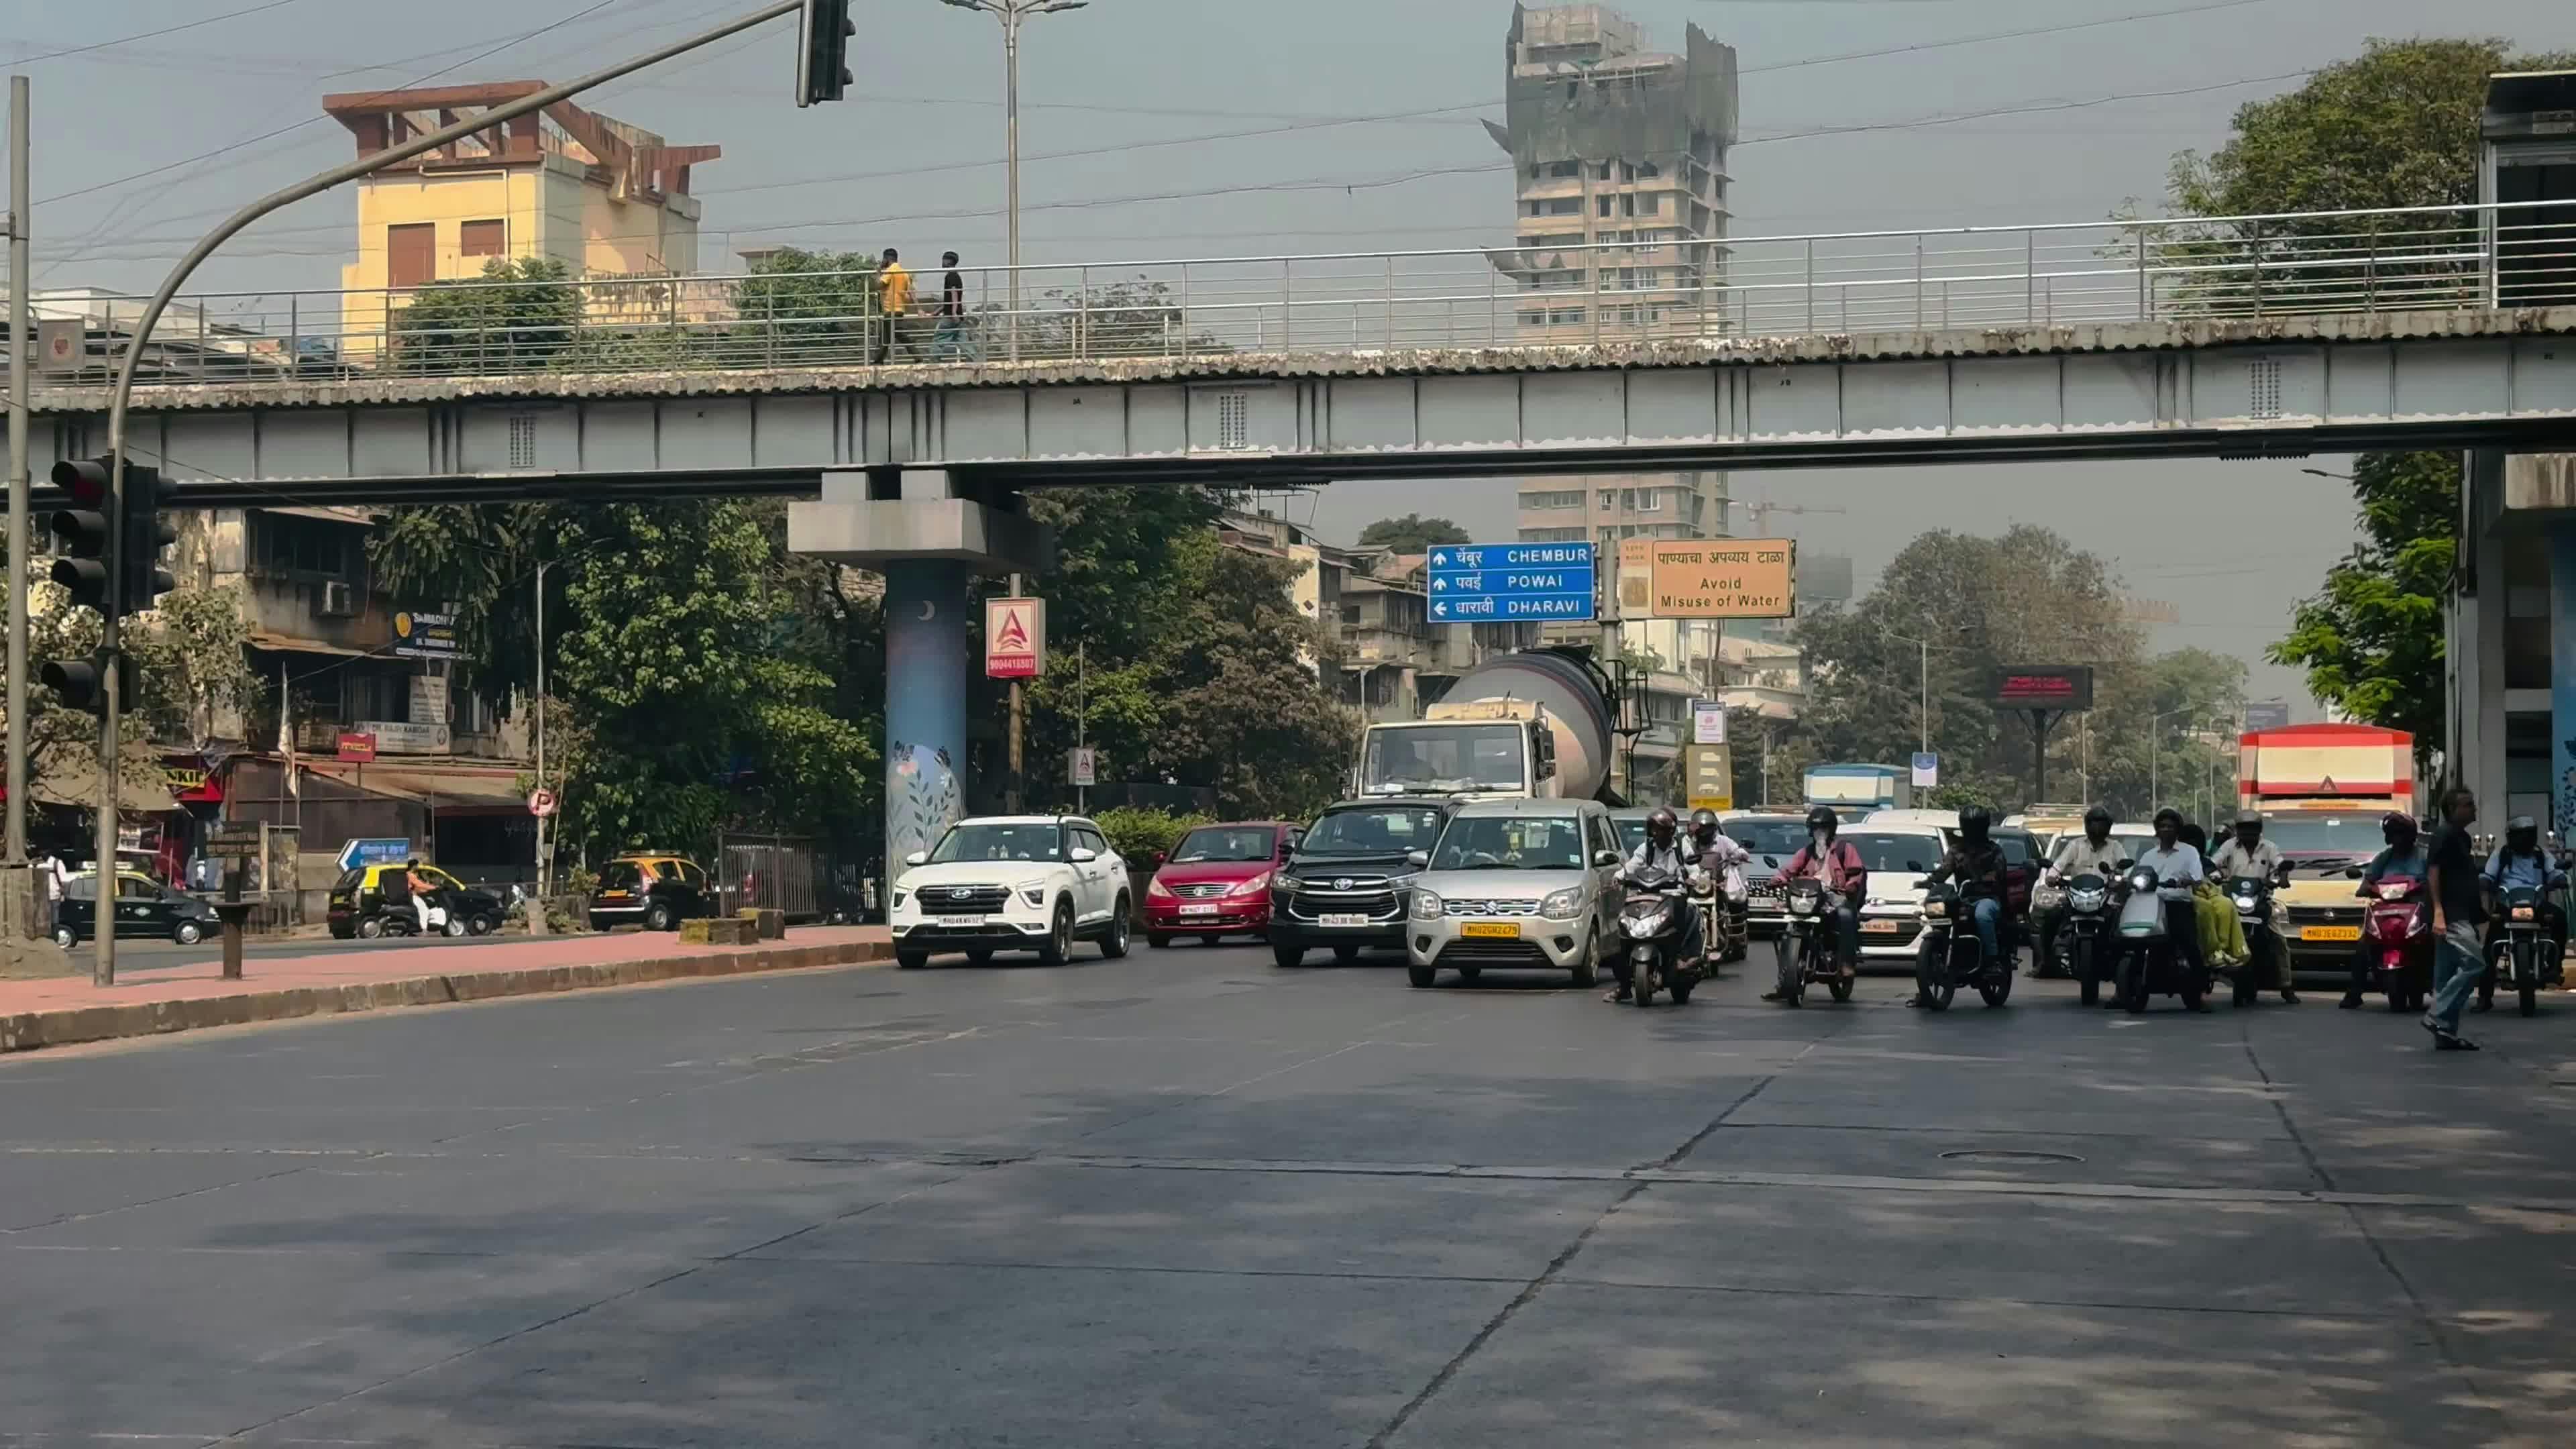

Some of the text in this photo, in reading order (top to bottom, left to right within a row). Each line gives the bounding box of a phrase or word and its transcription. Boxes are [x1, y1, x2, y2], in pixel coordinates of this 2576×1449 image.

[1507, 548, 1588, 563] CHEMBUR
[1658, 552, 1702, 565] पाण्याचा
[1708, 551, 1750, 564] अपव्यय
[1756, 551, 1784, 564] टाळा
[1455, 572, 1481, 590] पवई
[1507, 574, 1562, 588] POWAI
[1701, 577, 1741, 590] Avoid
[1455, 596, 1494, 614] धारावी
[1508, 600, 1579, 614] DHARAVI
[1661, 594, 1780, 608] Misuse of Water
